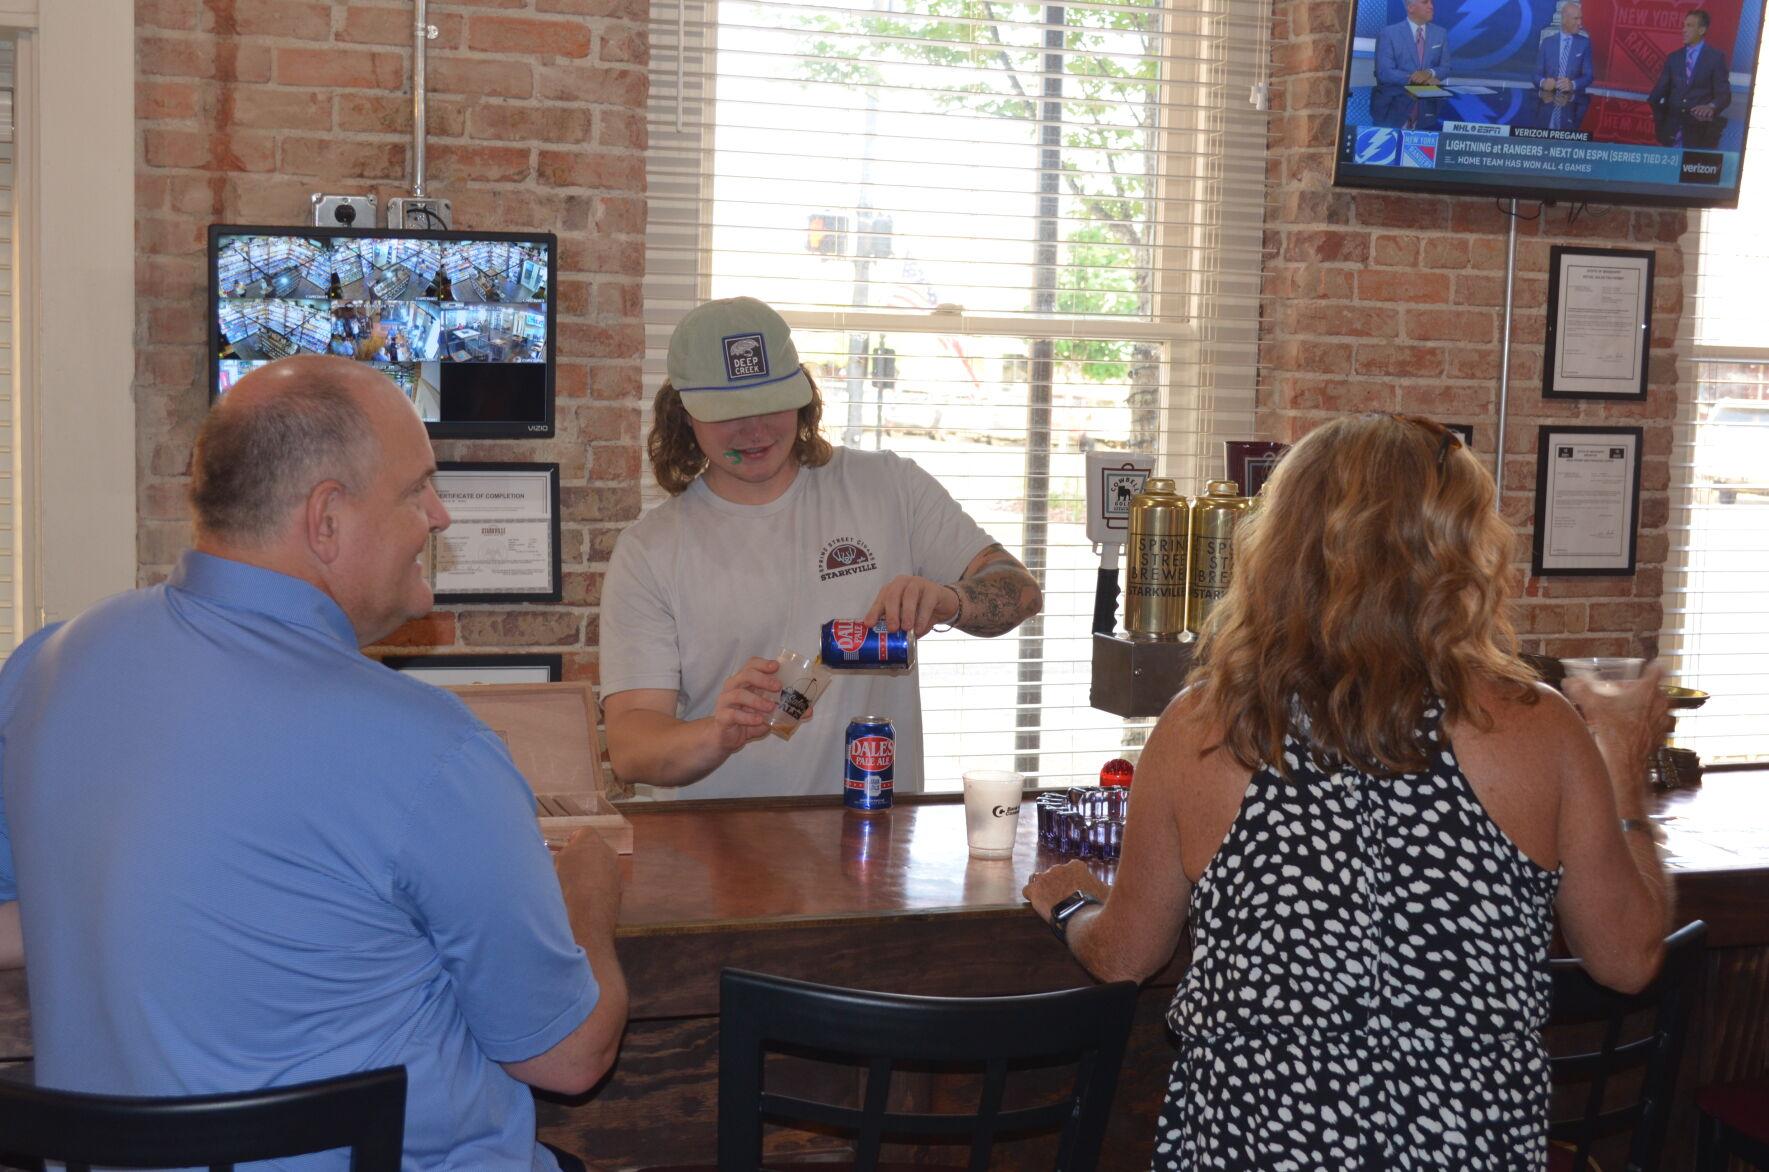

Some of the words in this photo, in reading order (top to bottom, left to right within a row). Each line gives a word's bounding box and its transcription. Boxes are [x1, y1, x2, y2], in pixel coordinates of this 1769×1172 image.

[1617, 7, 1648, 25] NEW
[1453, 123, 1471, 132] NHL
[1477, 125, 1501, 134] ESPN
[1515, 128, 1548, 138] VERIZON
[1549, 130, 1589, 141] PREGAME
[1445, 140, 1491, 153] LIGHTNING
[1492, 144, 1502, 154] at
[1503, 144, 1543, 156] RANGERS
[1549, 147, 1572, 158] NEXT
[1572, 148, 1585, 159] ON
[1586, 149, 1609, 160] ESPN
[1643, 153, 1661, 164] TIED
[1458, 156, 1481, 165] HOME
[1482, 157, 1504, 167] TEAM
[1505, 159, 1522, 168] HAS
[1522, 160, 1541, 169] WON
[1542, 161, 1557, 171] ALL
[1557, 162, 1564, 171] 4
[1564, 163, 1592, 173] GAMES
[1682, 163, 1717, 174] verizon
[733, 357, 758, 367] DEEP
[735, 366, 760, 375] CREEK
[828, 536, 854, 547] STREET
[1139, 538, 1184, 552] SPRIN
[1140, 553, 1185, 567] STREE
[820, 562, 878, 582] STARKVILLE
[1131, 567, 1185, 581] BREWE
[856, 757, 875, 766] PALE
[877, 757, 891, 766] ALE
